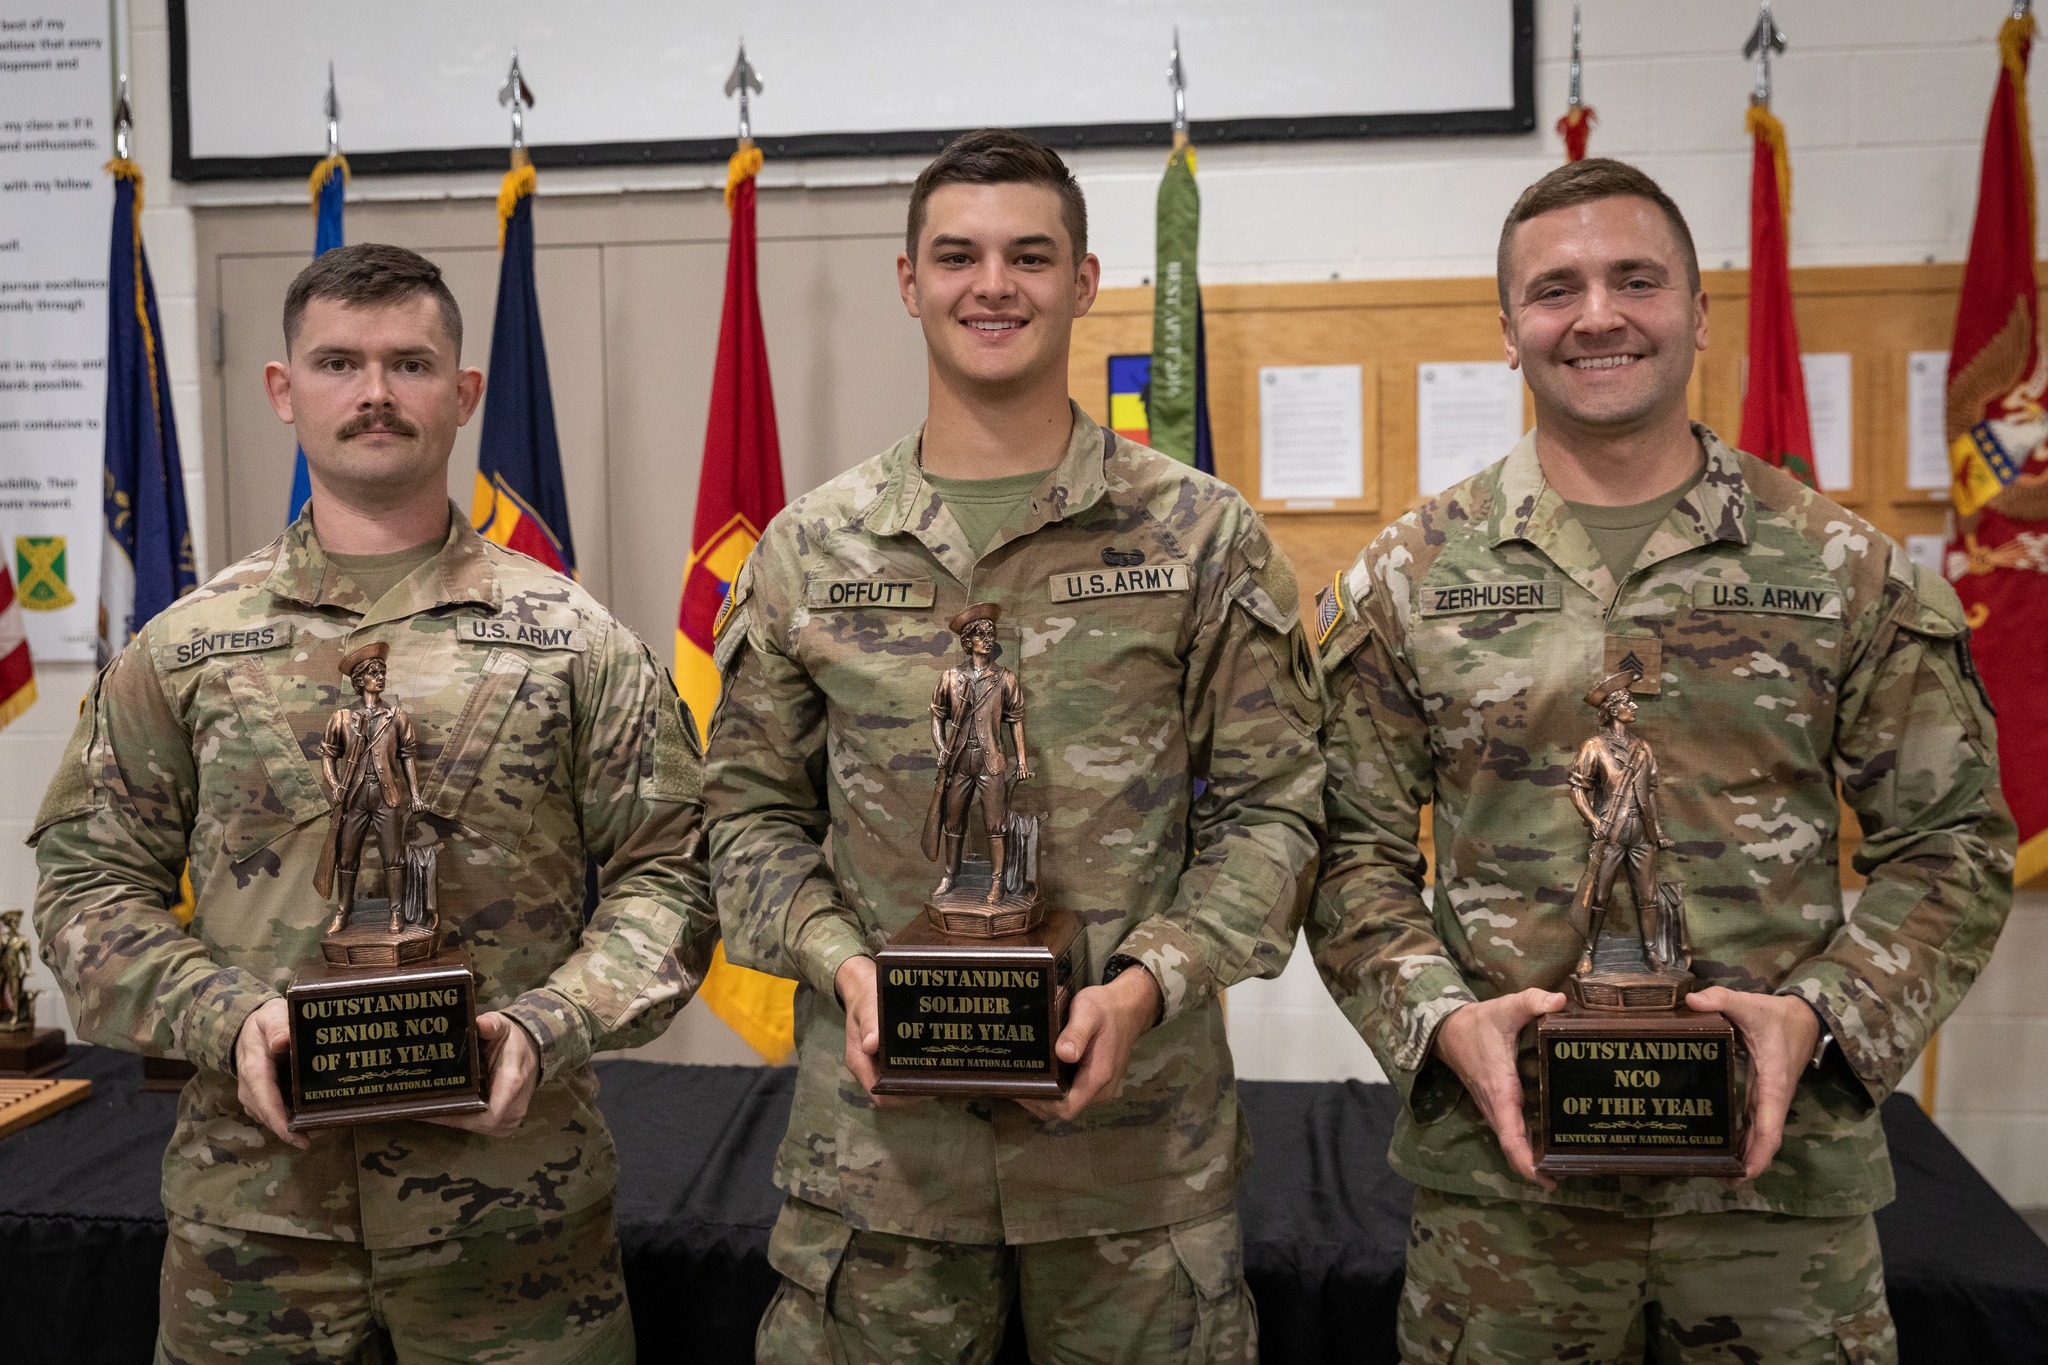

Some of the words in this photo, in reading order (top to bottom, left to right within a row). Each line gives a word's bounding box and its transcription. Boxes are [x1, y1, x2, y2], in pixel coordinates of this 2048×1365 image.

[829, 582, 912, 603] OFFUTT
[1434, 585, 1544, 610] ZERHUSEN
[1713, 586, 1754, 607] U.S.
[1762, 589, 1827, 613] ARMY
[472, 621, 510, 638] U.S.
[516, 625, 573, 645] ARMY
[176, 628, 274, 663] SENTERS
[889, 968, 1040, 988] OUTSTANDING
[302, 988, 458, 1019] OUTSTANDING
[919, 996, 1011, 1014] SOLDIER
[316, 1021, 399, 1045] SENIOR
[405, 1016, 449, 1037] NCO
[897, 1022, 925, 1039] OF
[929, 1023, 973, 1040] THE
[978, 1024, 1036, 1041] YEAR
[312, 1053, 341, 1072] OF
[346, 1048, 392, 1069] THE
[397, 1042, 456, 1064] YEAR
[1554, 1041, 1718, 1060] OUTSTANDING
[890, 1056, 938, 1066] KENTUCKY
[940, 1058, 965, 1067] ARMY
[967, 1058, 1012, 1068] NATIONAL
[1013, 1059, 1045, 1068] GUARD
[305, 1086, 356, 1100] KENTUCKY
[358, 1084, 384, 1095] ARMY
[386, 1078, 433, 1091] NATIONAL
[433, 1076, 466, 1088] GUARD
[1614, 1070, 1661, 1088] NCO
[1562, 1097, 1592, 1115] OF
[1597, 1097, 1646, 1116] THE
[1650, 1098, 1714, 1117] YEAR
[1554, 1134, 1607, 1144] KENTUCKY
[1609, 1134, 1637, 1144] ARMY
[1639, 1135, 1688, 1144] NATIONAL
[1689, 1135, 1724, 1145] GUARD
